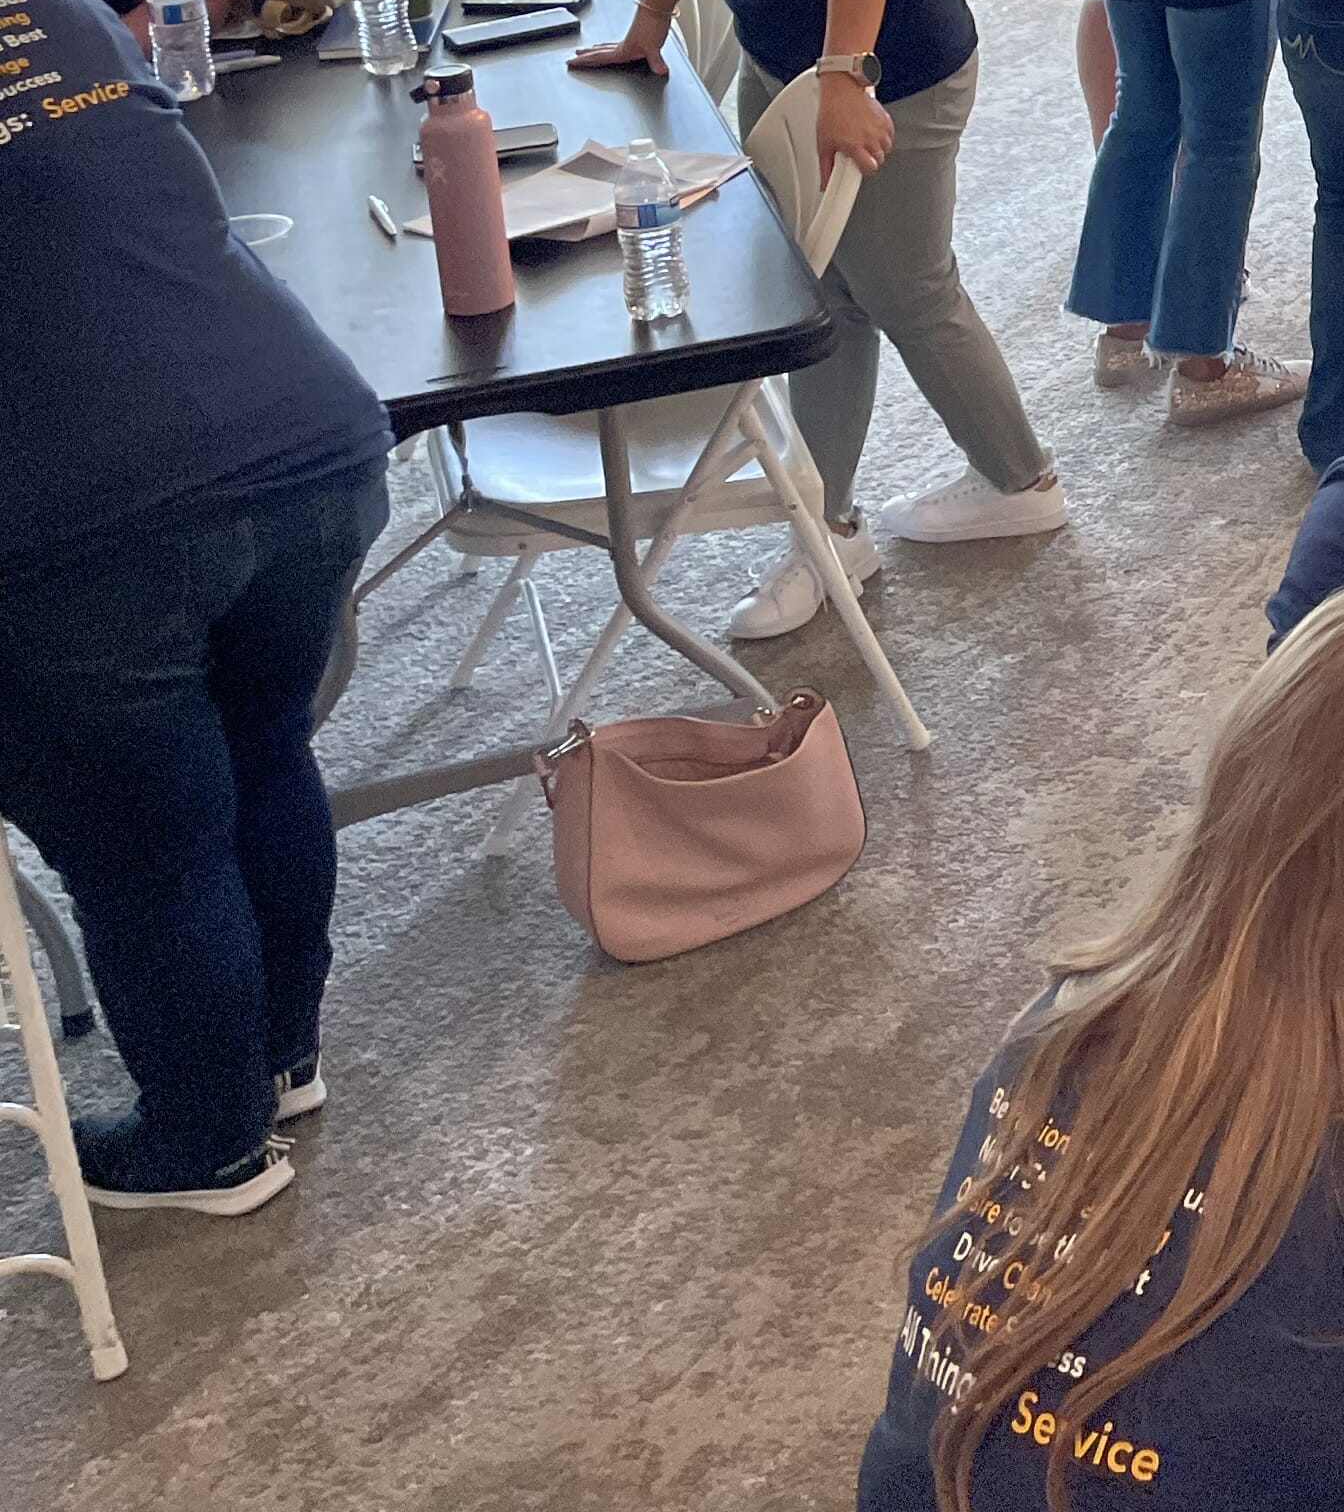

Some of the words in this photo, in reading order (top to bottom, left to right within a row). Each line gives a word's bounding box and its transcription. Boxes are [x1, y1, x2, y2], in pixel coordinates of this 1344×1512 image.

[4, 28, 47, 48] Best
[42, 81, 129, 119] Service
[989, 1087, 1010, 1119] Be
[925, 1266, 998, 1333] Celerate
[1011, 1391, 1160, 1481] Sevice
